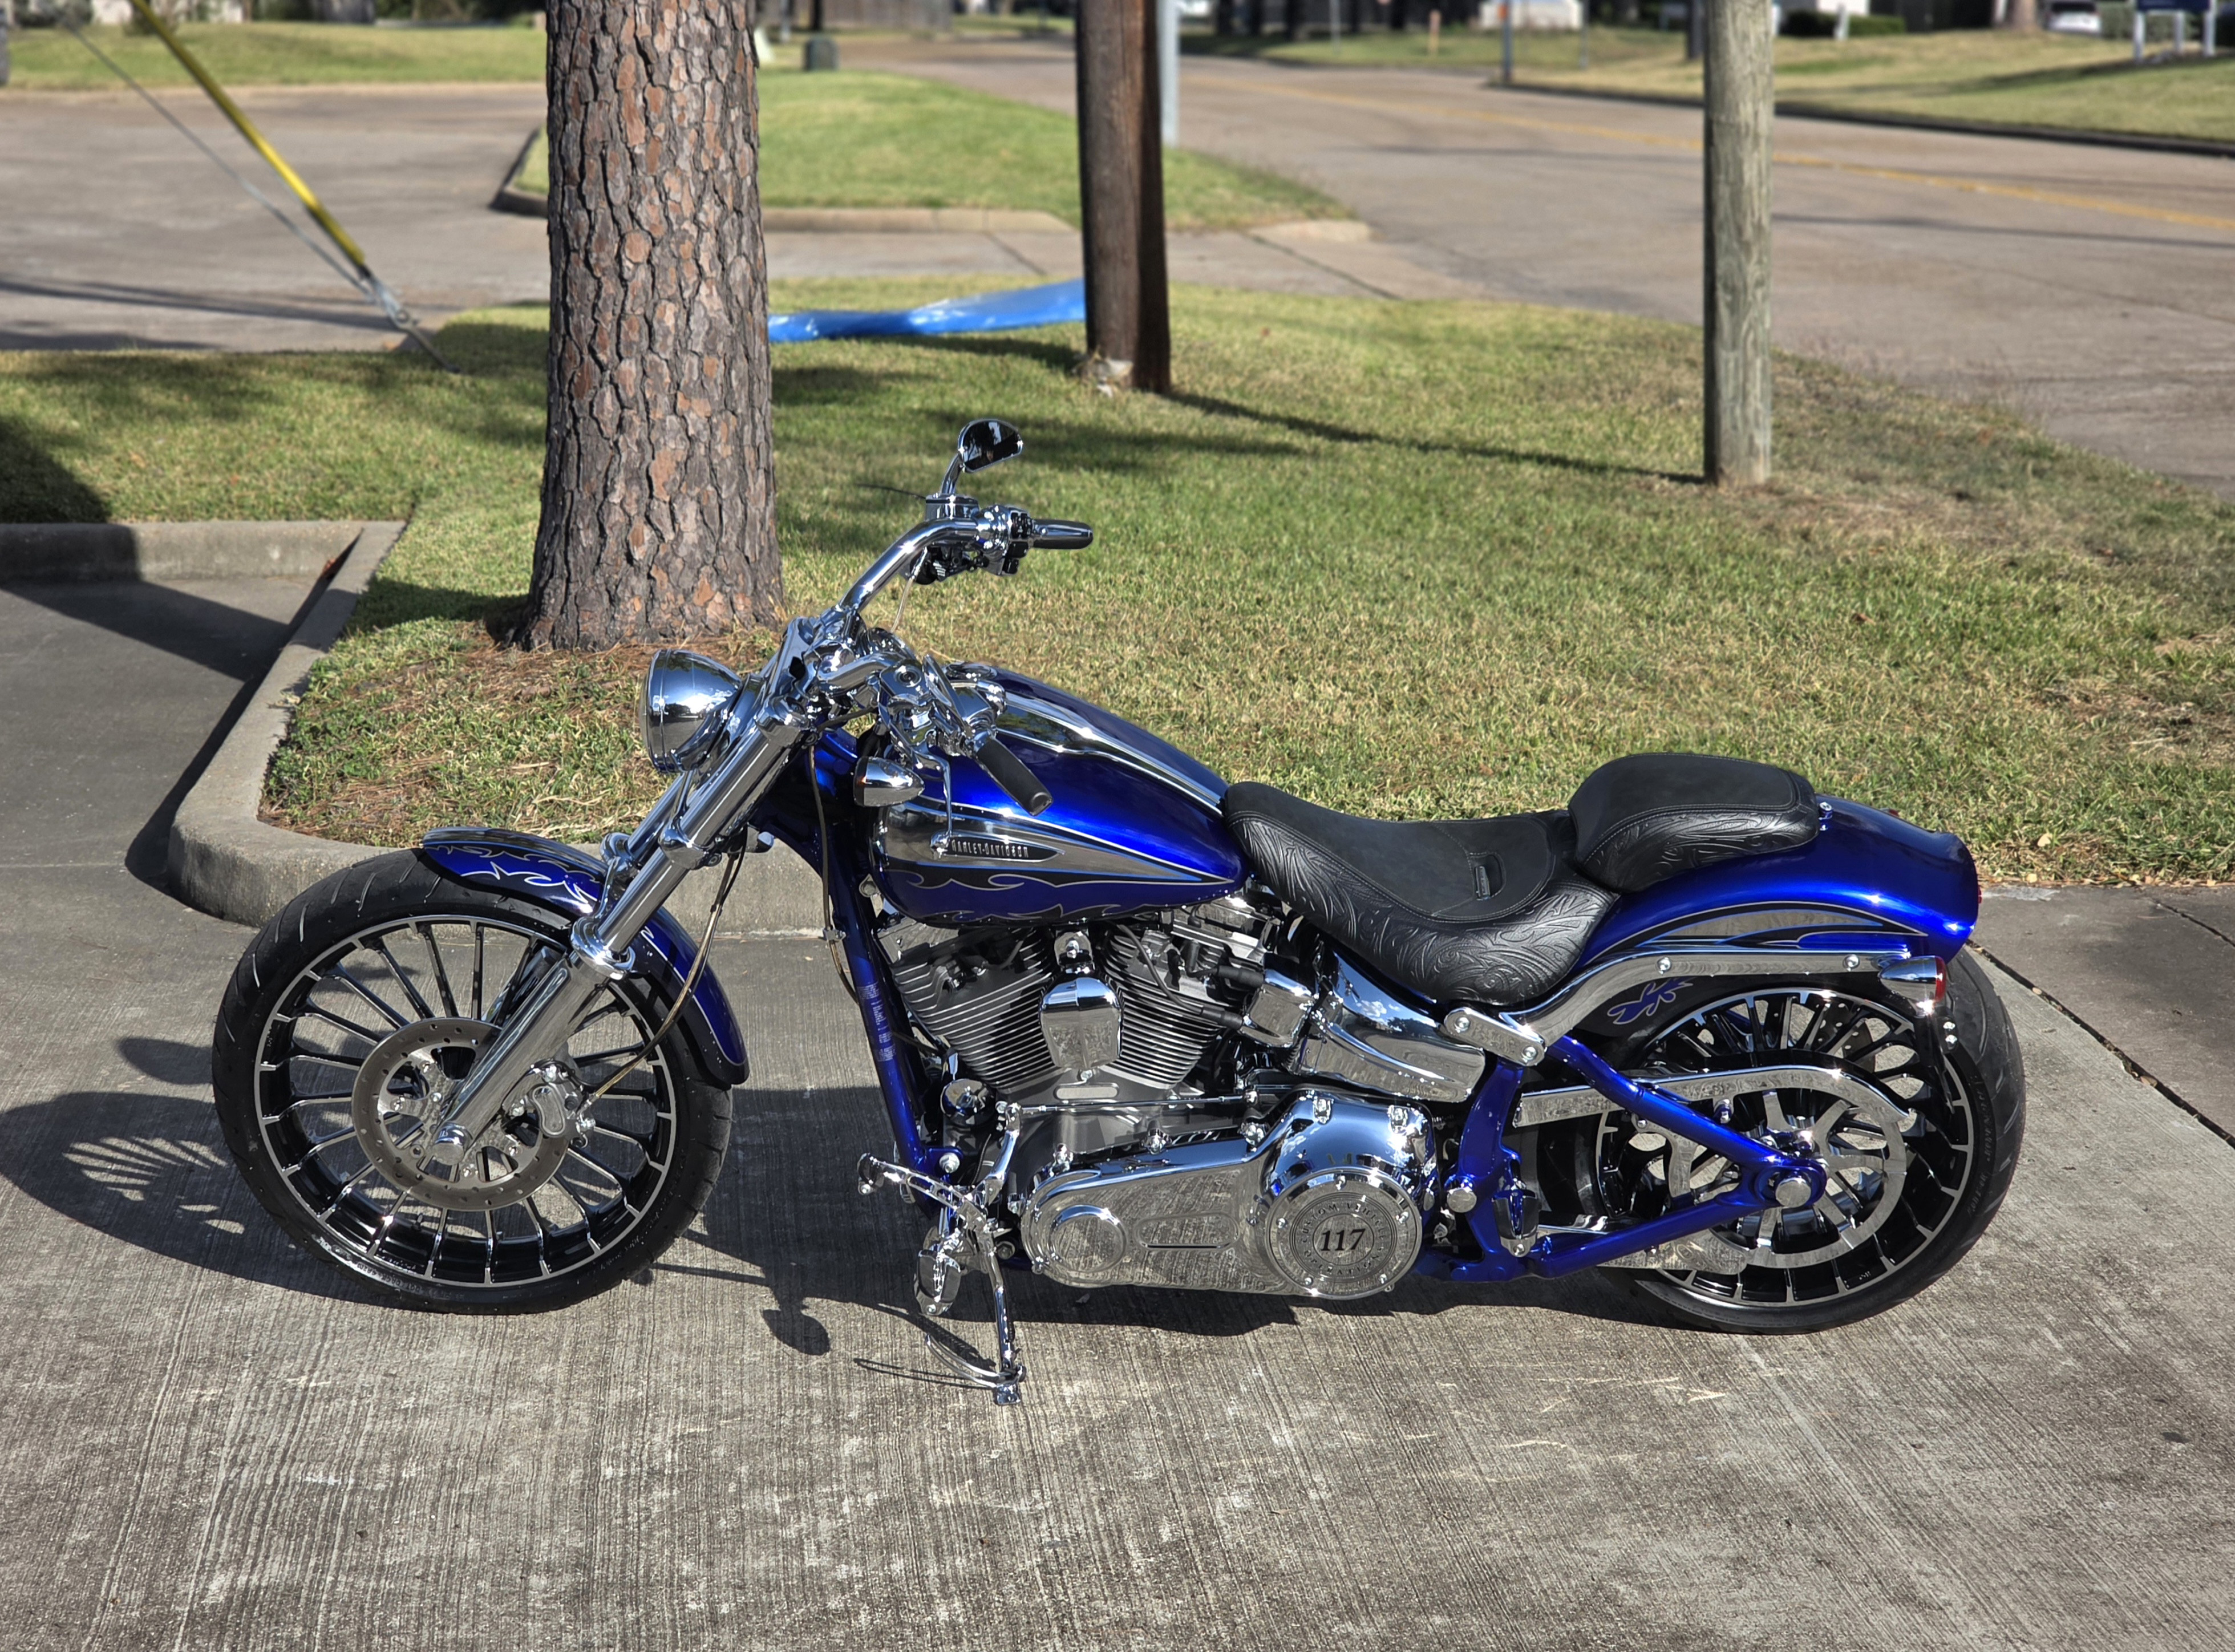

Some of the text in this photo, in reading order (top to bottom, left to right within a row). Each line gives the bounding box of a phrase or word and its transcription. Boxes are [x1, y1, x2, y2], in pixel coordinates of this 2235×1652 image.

[952, 839, 1029, 857] HARLEY-DAVIDSON
[1301, 1204, 1339, 1243] CUSTOM
[1321, 1228, 1366, 1251] 117
[1305, 1247, 1383, 1275] OPERATIONS
